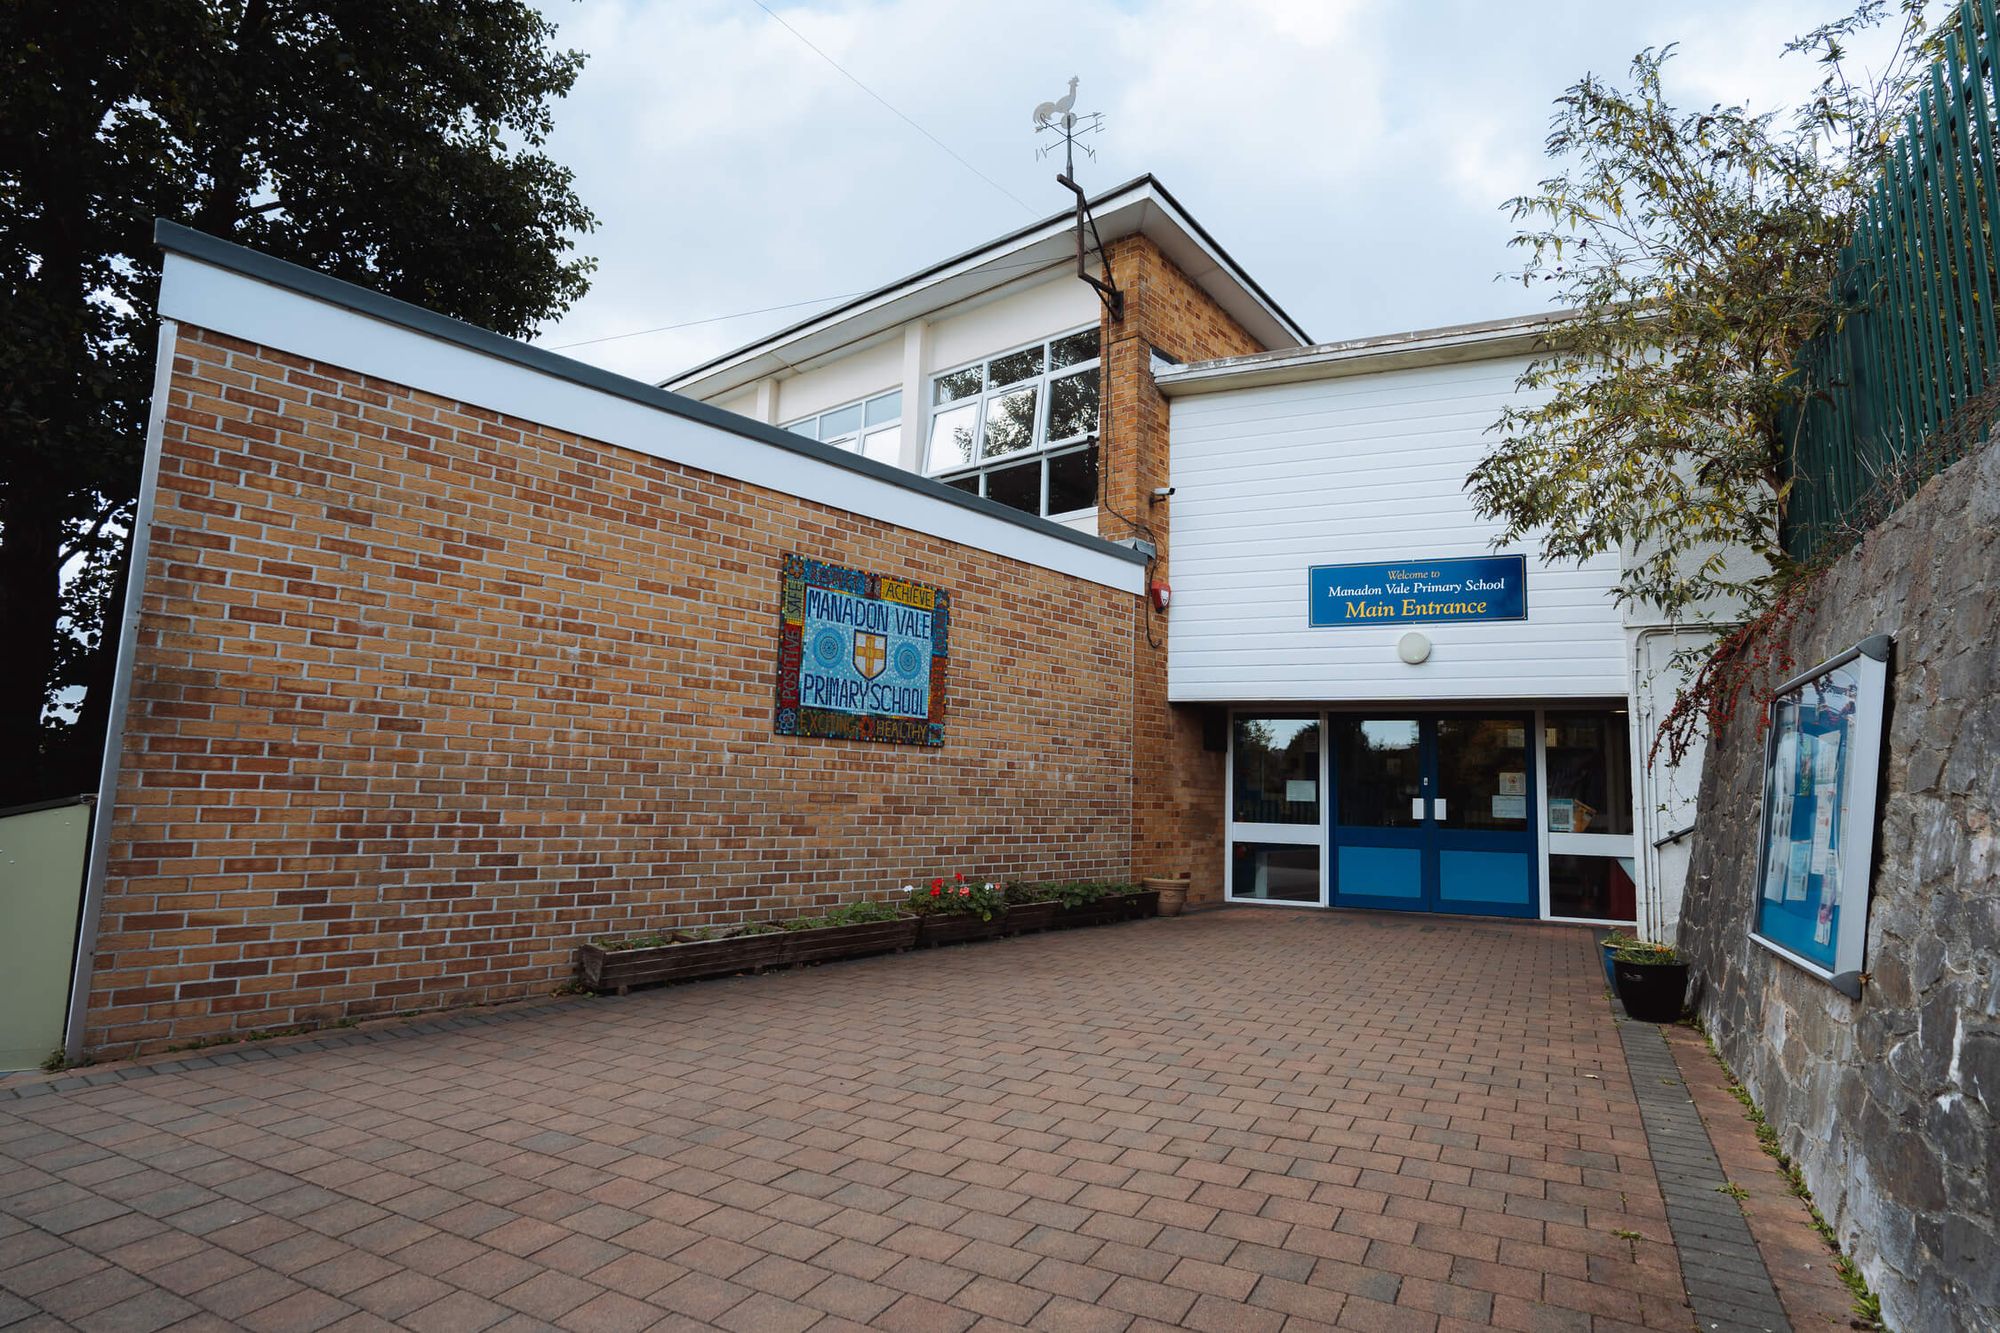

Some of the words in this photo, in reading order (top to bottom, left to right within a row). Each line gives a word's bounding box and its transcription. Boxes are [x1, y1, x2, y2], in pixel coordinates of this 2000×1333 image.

[1328, 585, 1382, 597] Manadon
[1385, 583, 1410, 594] Vale
[1413, 580, 1462, 595] Primary
[1465, 578, 1505, 591] School
[1388, 570, 1428, 581] Welcome
[1431, 570, 1440, 579] to
[787, 581, 801, 616] SAFE
[886, 582, 932, 608] ACHIEVE
[807, 589, 889, 632] MANADON
[895, 607, 931, 638] VALE
[1345, 601, 1395, 619] Main
[1401, 599, 1487, 617] Entrance
[782, 629, 800, 700] POSITIVE
[803, 673, 869, 710] PRIMARY
[869, 683, 926, 716] SCHOOL
[876, 719, 928, 740] HEALTHY
